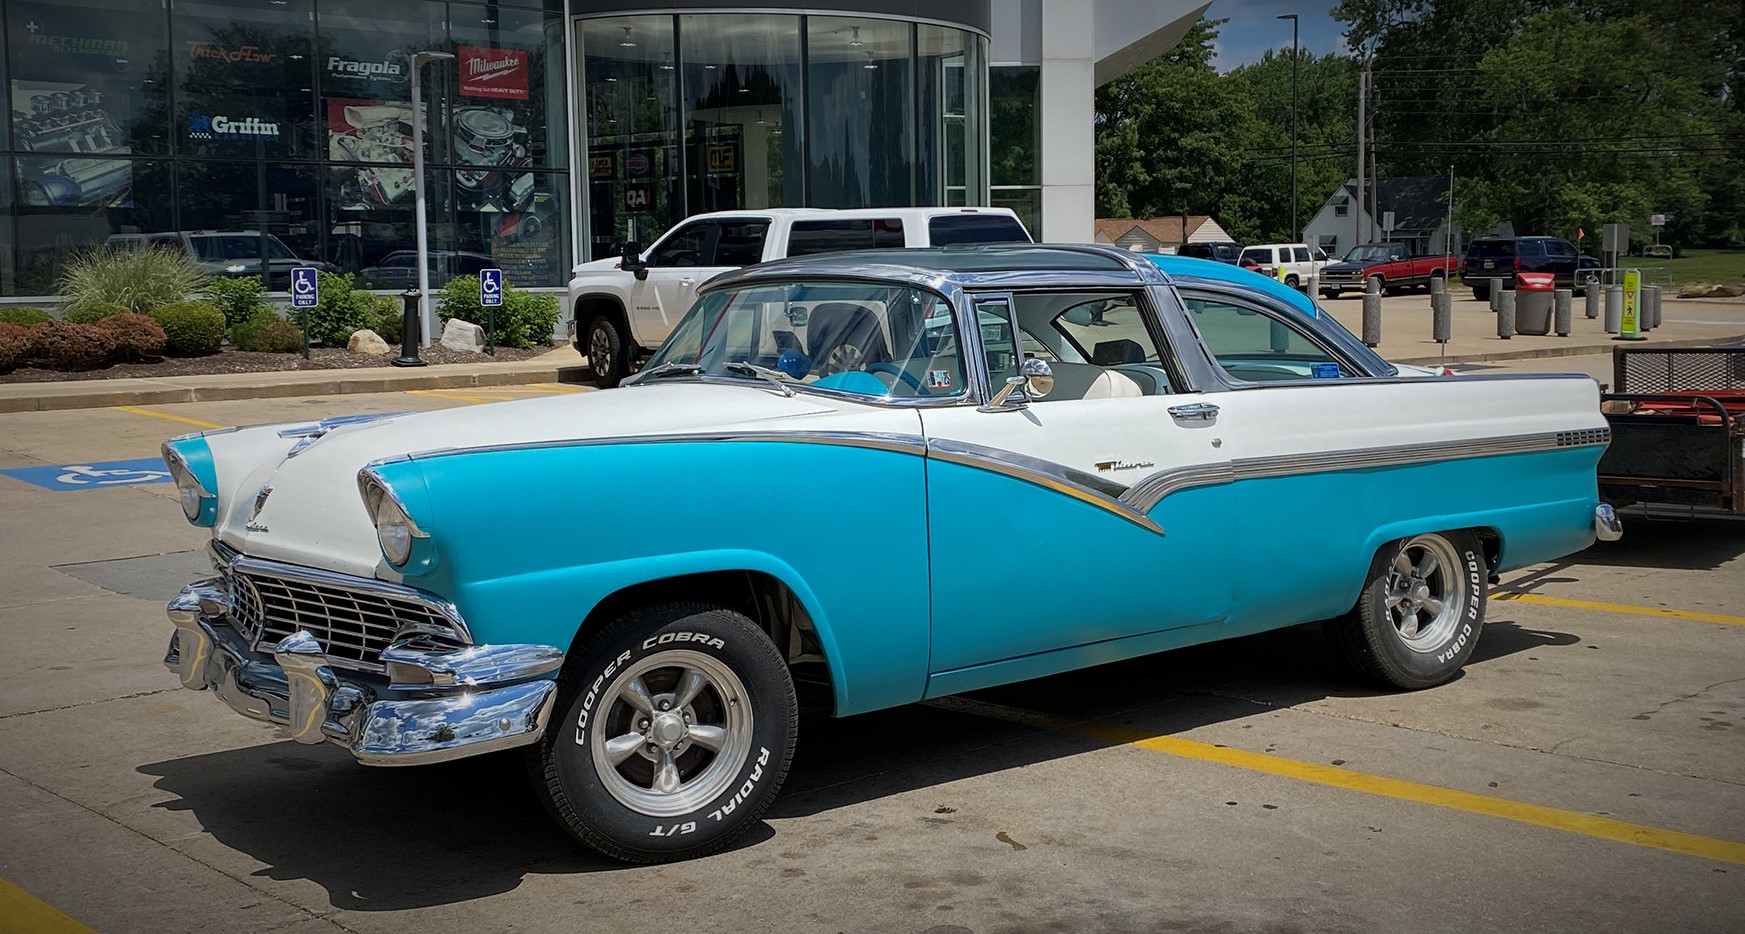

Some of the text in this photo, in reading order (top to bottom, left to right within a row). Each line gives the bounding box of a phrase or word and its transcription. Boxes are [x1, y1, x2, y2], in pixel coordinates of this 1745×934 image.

[28, 34, 129, 51] MECHMAN
[327, 57, 400, 76] Fragola
[465, 56, 520, 75] Milwaukee
[211, 115, 280, 135] Griffin
[1465, 551, 1480, 620] COOPER
[1437, 624, 1472, 664] COBRA
[575, 632, 725, 746] COOPER COBRA
[649, 746, 770, 837] RADIAL G/T
